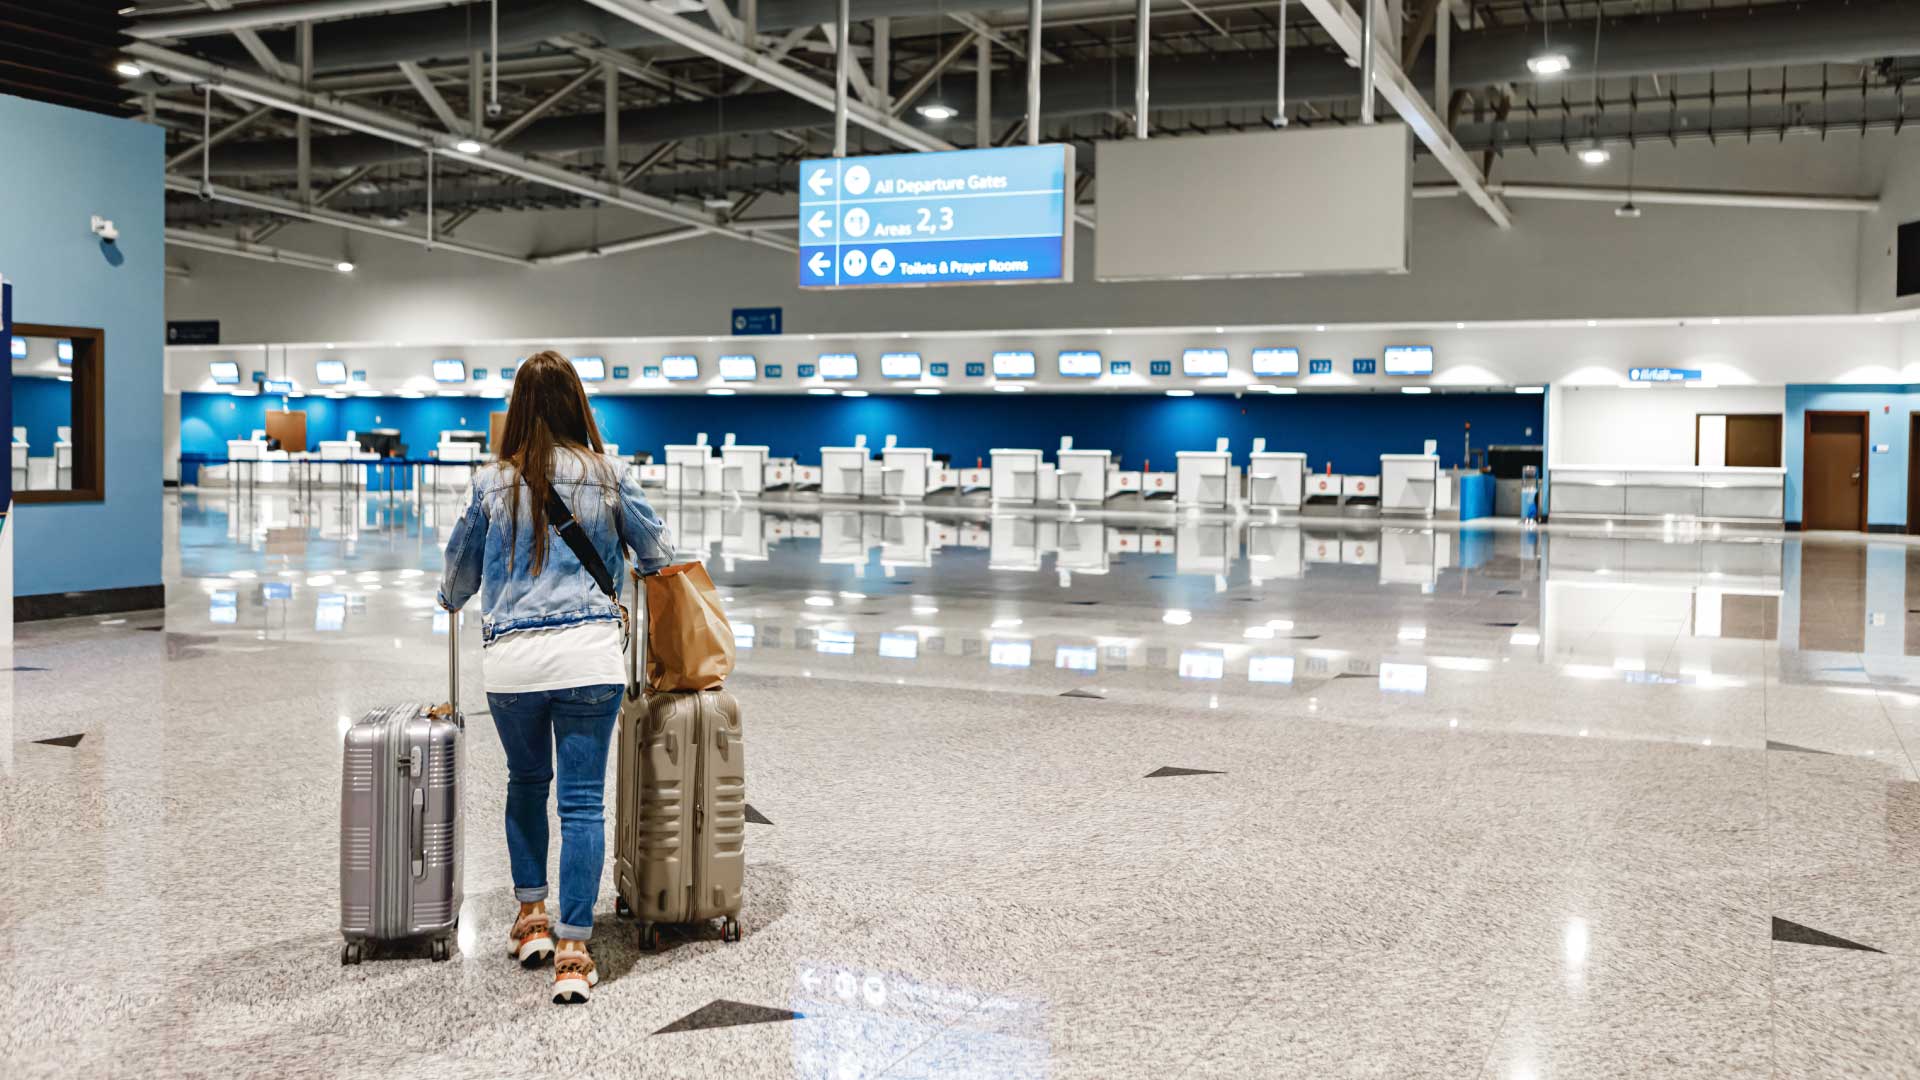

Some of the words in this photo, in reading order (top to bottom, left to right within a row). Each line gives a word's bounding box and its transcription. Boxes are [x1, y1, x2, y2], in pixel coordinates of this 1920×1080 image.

[874, 179, 894, 194] All
[896, 178, 965, 195] Departure
[967, 174, 1008, 189] Gates
[873, 223, 912, 237] Areas
[900, 262, 937, 275] Toilets
[938, 261, 948, 274] &
[950, 260, 987, 276] Prayer
[988, 259, 1028, 272] Rooms
